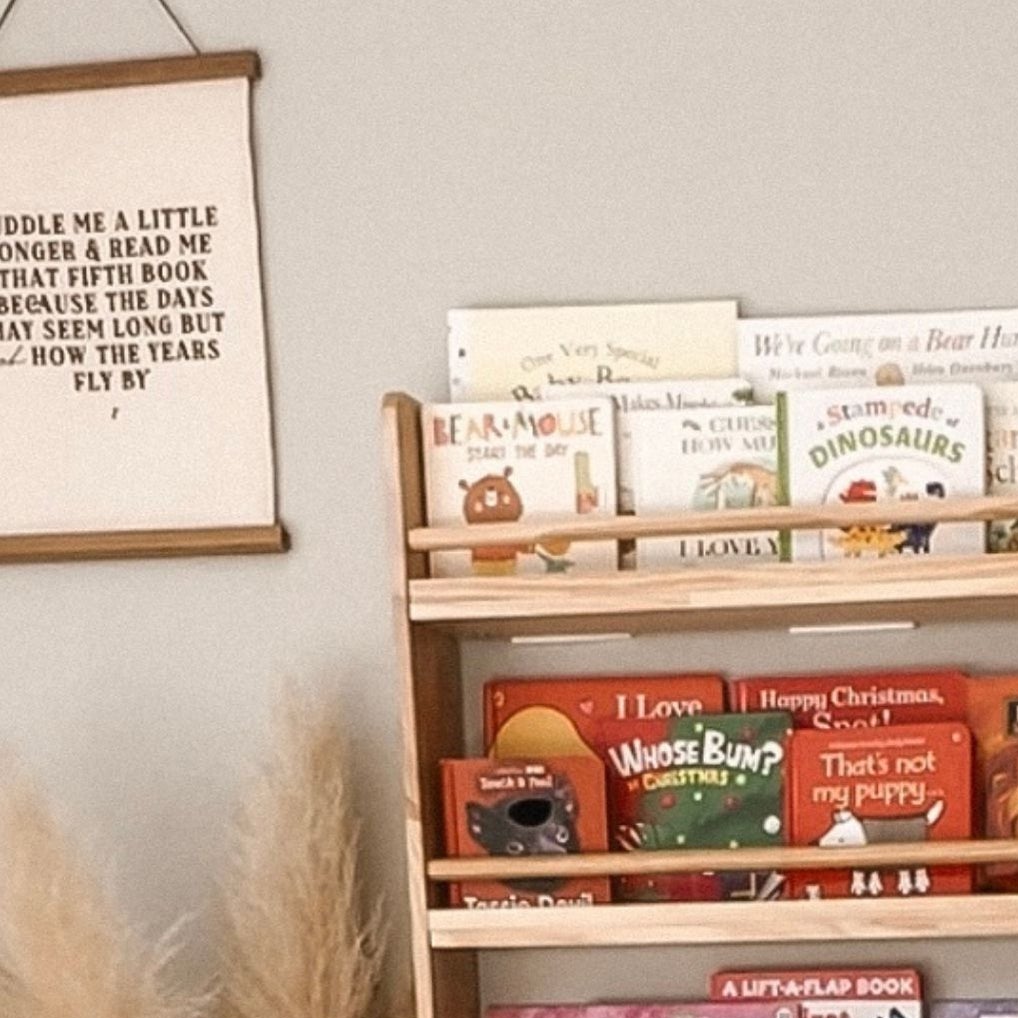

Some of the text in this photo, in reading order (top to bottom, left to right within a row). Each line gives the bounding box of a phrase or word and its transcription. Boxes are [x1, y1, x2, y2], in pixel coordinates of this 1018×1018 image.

[73, 211, 107, 234] ME
[114, 210, 130, 231] A
[138, 205, 219, 231] LITTLE
[85, 238, 102, 262] &
[109, 235, 171, 259] READ
[178, 233, 213, 256] ME
[0, 259, 209, 289] THAT FIFTH BOOK
[105, 289, 150, 312] THE
[157, 285, 215, 309] DAYS
[42, 318, 104, 341] SEEM
[113, 314, 172, 337] LONG
[180, 311, 226, 334] BUT
[31, 345, 86, 366] HOW
[96, 343, 140, 365] THE
[147, 338, 221, 362] YEARS
[754, 333, 804, 357] We're
[811, 331, 875, 359] Going
[877, 335, 902, 351] on
[905, 336, 920, 351] a
[926, 327, 974, 352] Bear
[73, 368, 151, 391] FLY BY
[433, 412, 503, 446] BEAR
[511, 406, 602, 436] MOUSE
[825, 397, 944, 426] Stampede
[808, 424, 967, 470] DINOSAURS
[616, 693, 703, 719] I Love
[760, 685, 945, 711] Happy Christmas,
[608, 729, 783, 778] WHOSE BUM?
[820, 751, 936, 778] That's not
[812, 786, 850, 809] my
[722, 980, 738, 997] A
[856, 977, 914, 996] BOOK
